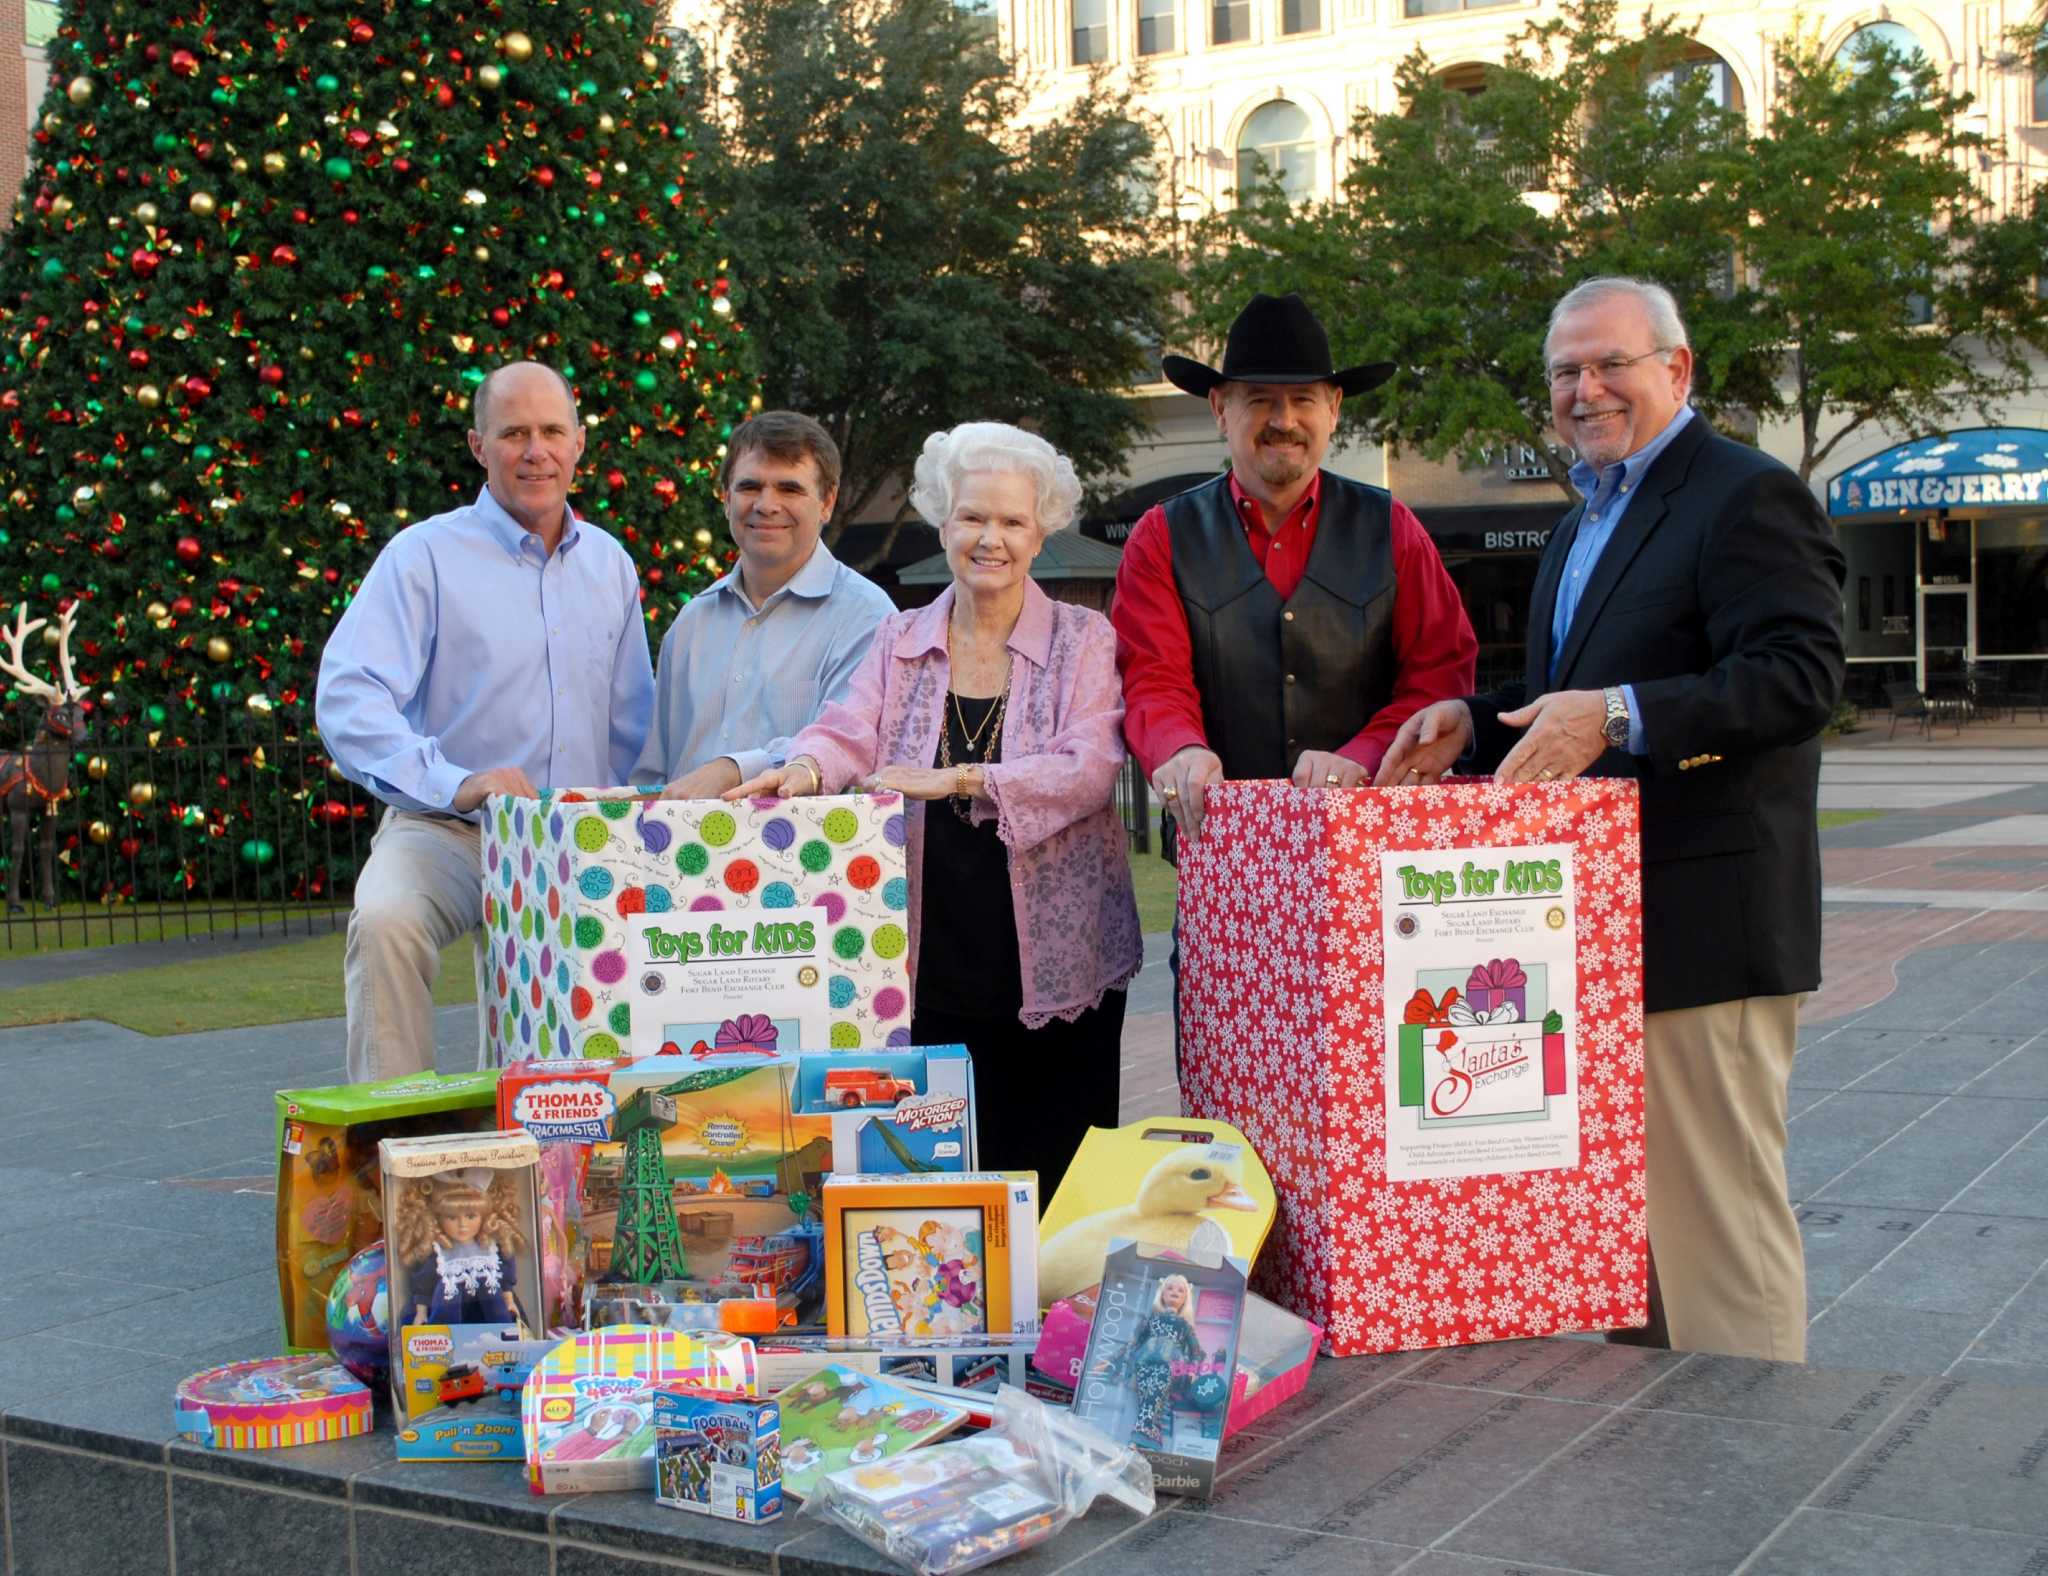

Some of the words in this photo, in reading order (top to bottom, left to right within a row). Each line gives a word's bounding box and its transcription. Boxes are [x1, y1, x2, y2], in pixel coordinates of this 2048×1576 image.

[1397, 865, 1456, 906] Toys
[1460, 861, 1499, 896] for
[1503, 859, 1563, 895] KIDS
[642, 926, 703, 966] Toys
[708, 923, 748, 956] for
[752, 921, 816, 954] KIDS
[1474, 1062, 1530, 1090] Exchange
[525, 1092, 604, 1108] THOMAS
[532, 1110, 541, 1119] &
[544, 1108, 599, 1119] FRIENDS
[896, 1098, 966, 1125] MOTORIZED
[909, 1110, 954, 1132] ACTION
[527, 1122, 603, 1137] TRACKMASTER
[413, 1339, 449, 1347] THOMAS
[574, 1378, 643, 1393] Friends
